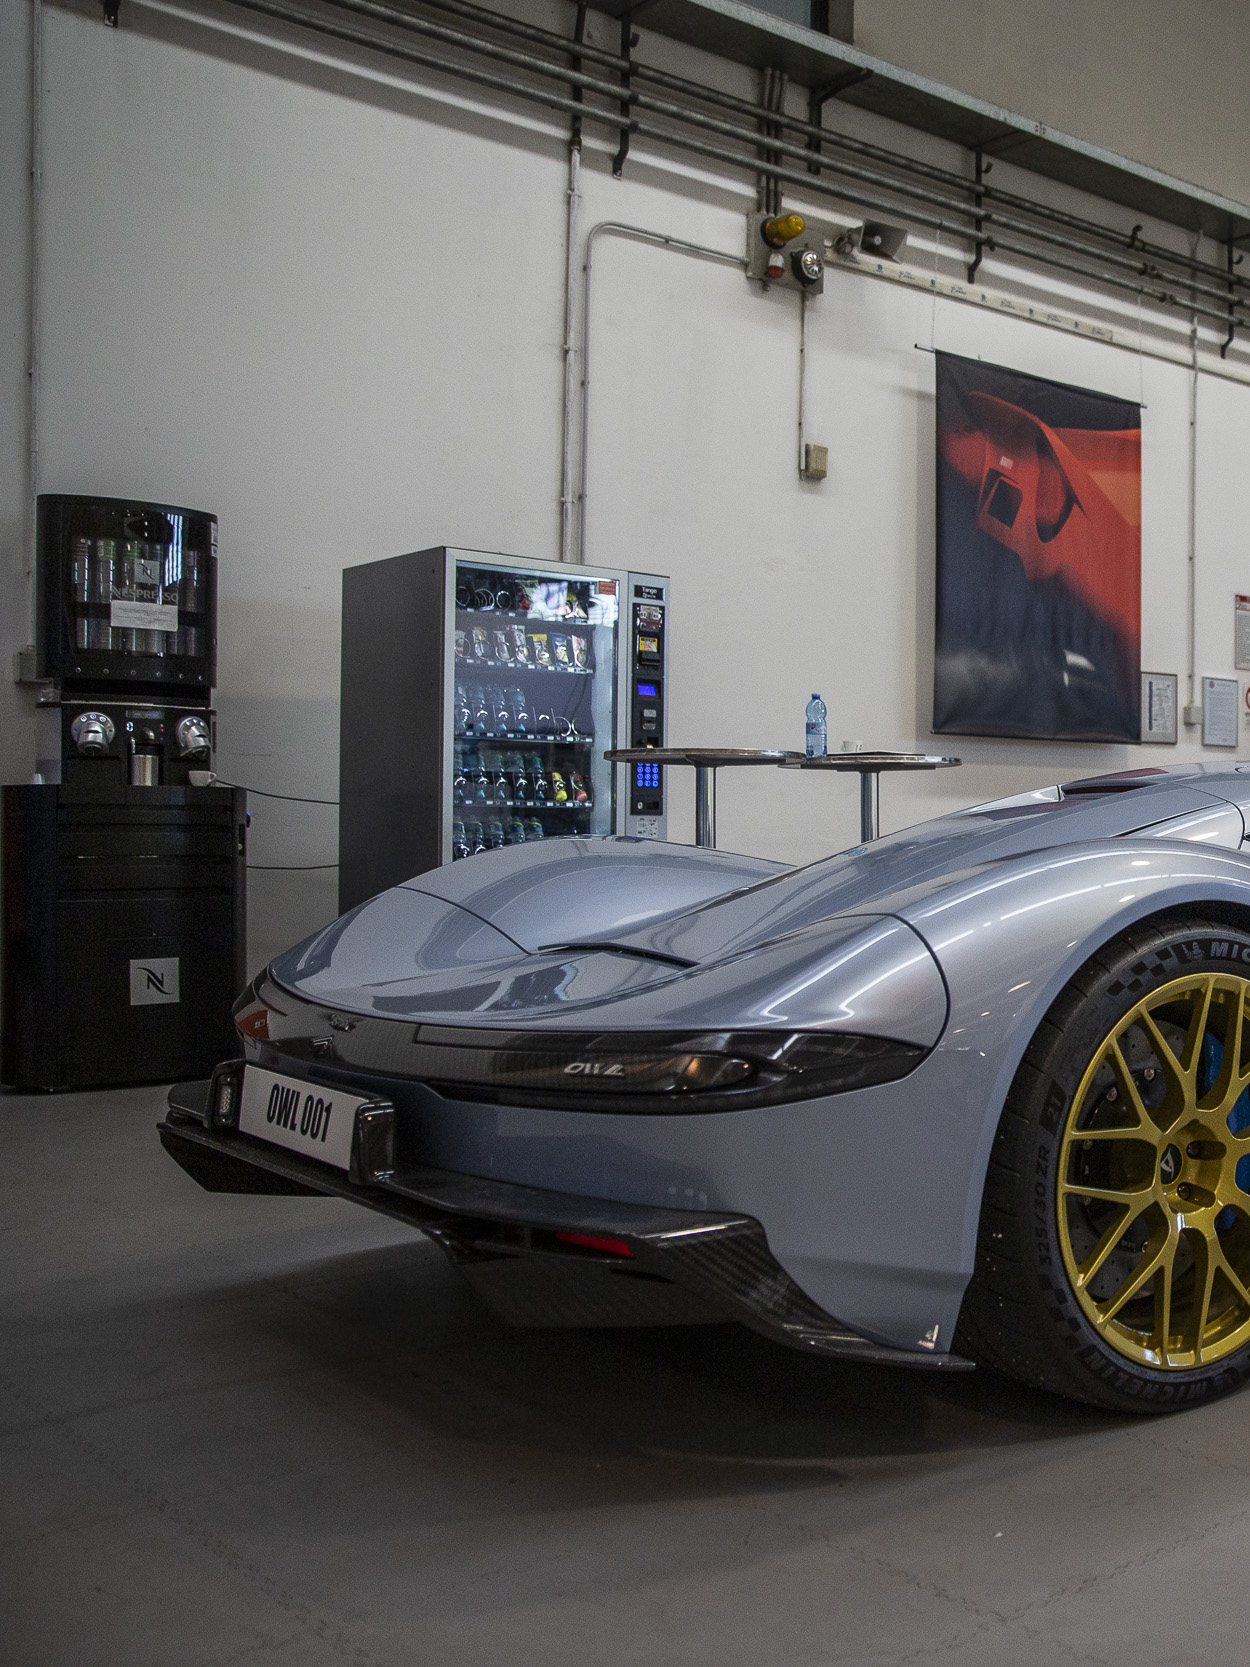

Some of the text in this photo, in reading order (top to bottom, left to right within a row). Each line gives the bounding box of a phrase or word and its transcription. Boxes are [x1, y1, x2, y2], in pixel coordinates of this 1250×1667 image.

[266, 1083, 333, 1143] OWL 001
[1034, 1096, 1061, 1266] 325/30 ZR 21
[1088, 1351, 1207, 1400] MICHELIN
